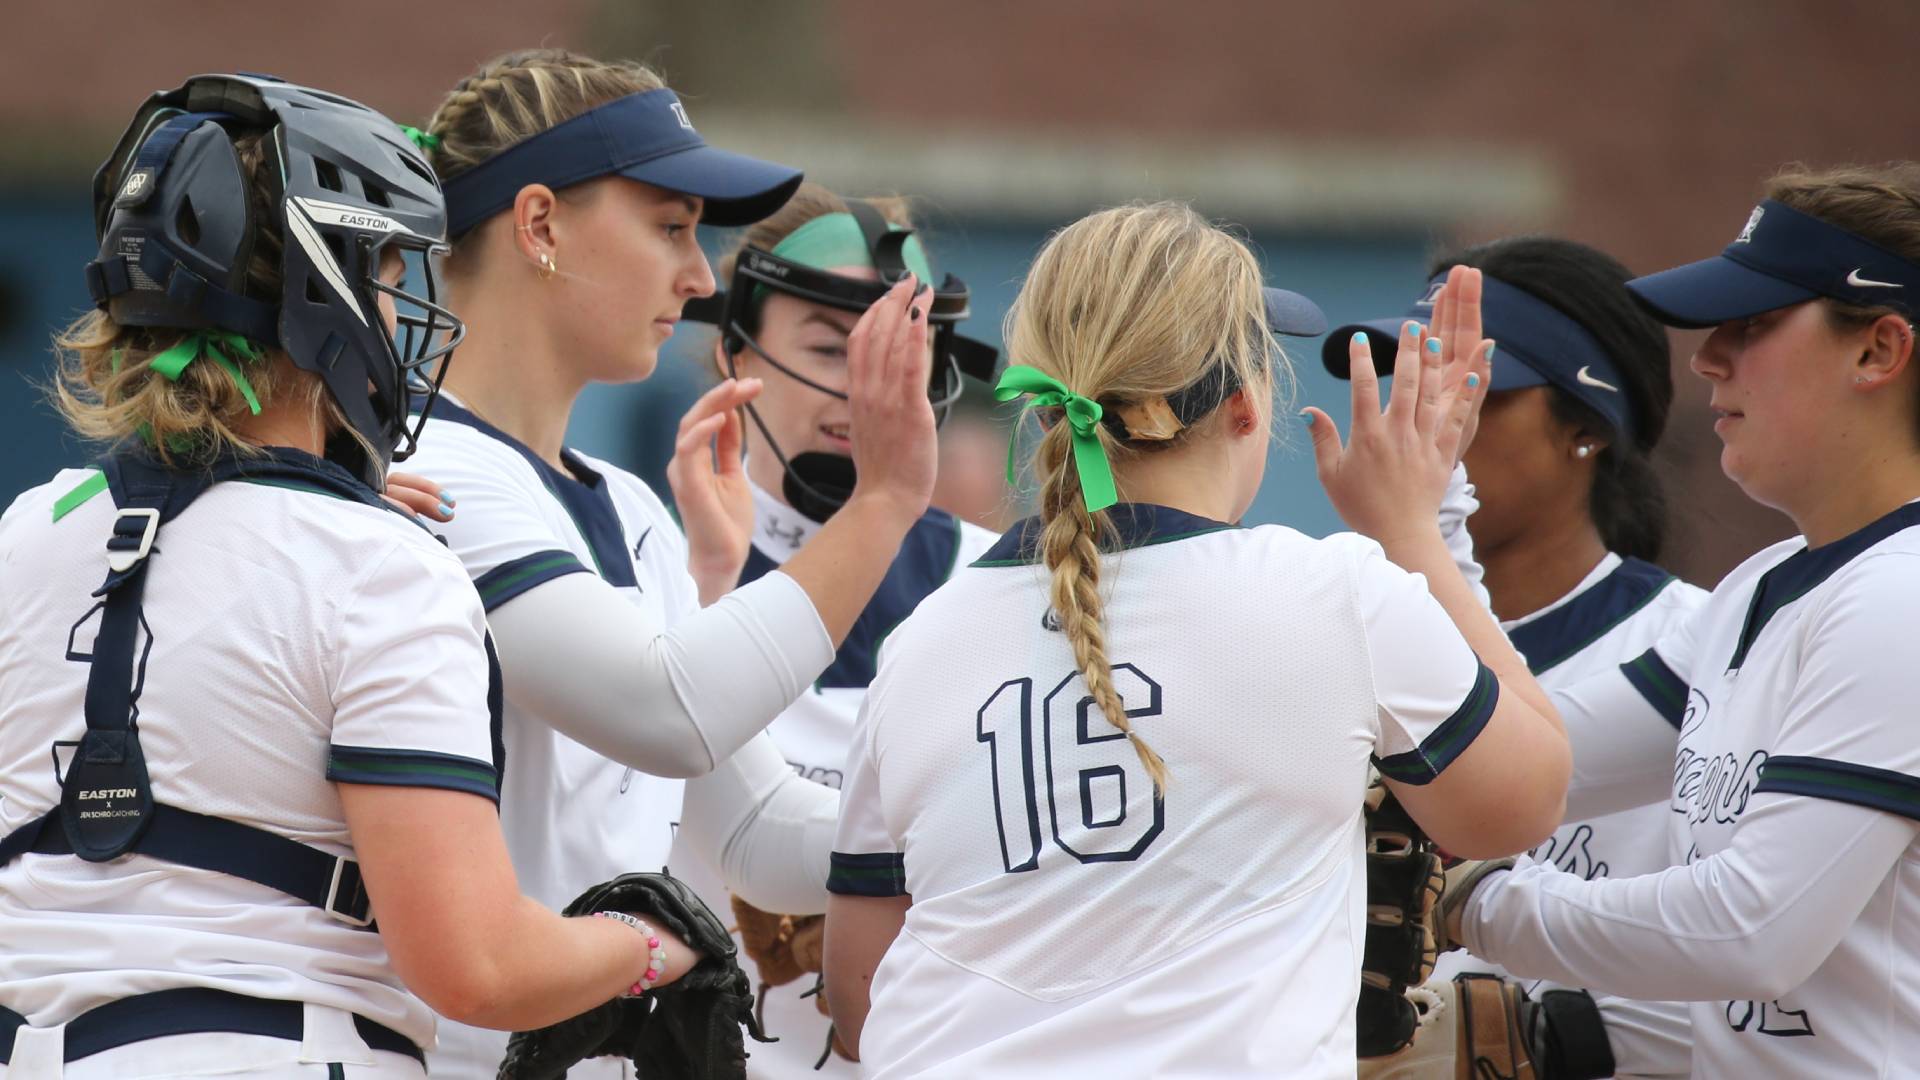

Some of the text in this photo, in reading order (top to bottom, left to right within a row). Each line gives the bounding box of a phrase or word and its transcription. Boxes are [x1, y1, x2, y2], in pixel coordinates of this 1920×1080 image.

[340, 214, 389, 229] EASTON
[977, 662, 1165, 873] 16
[79, 788, 137, 800] EASTON
